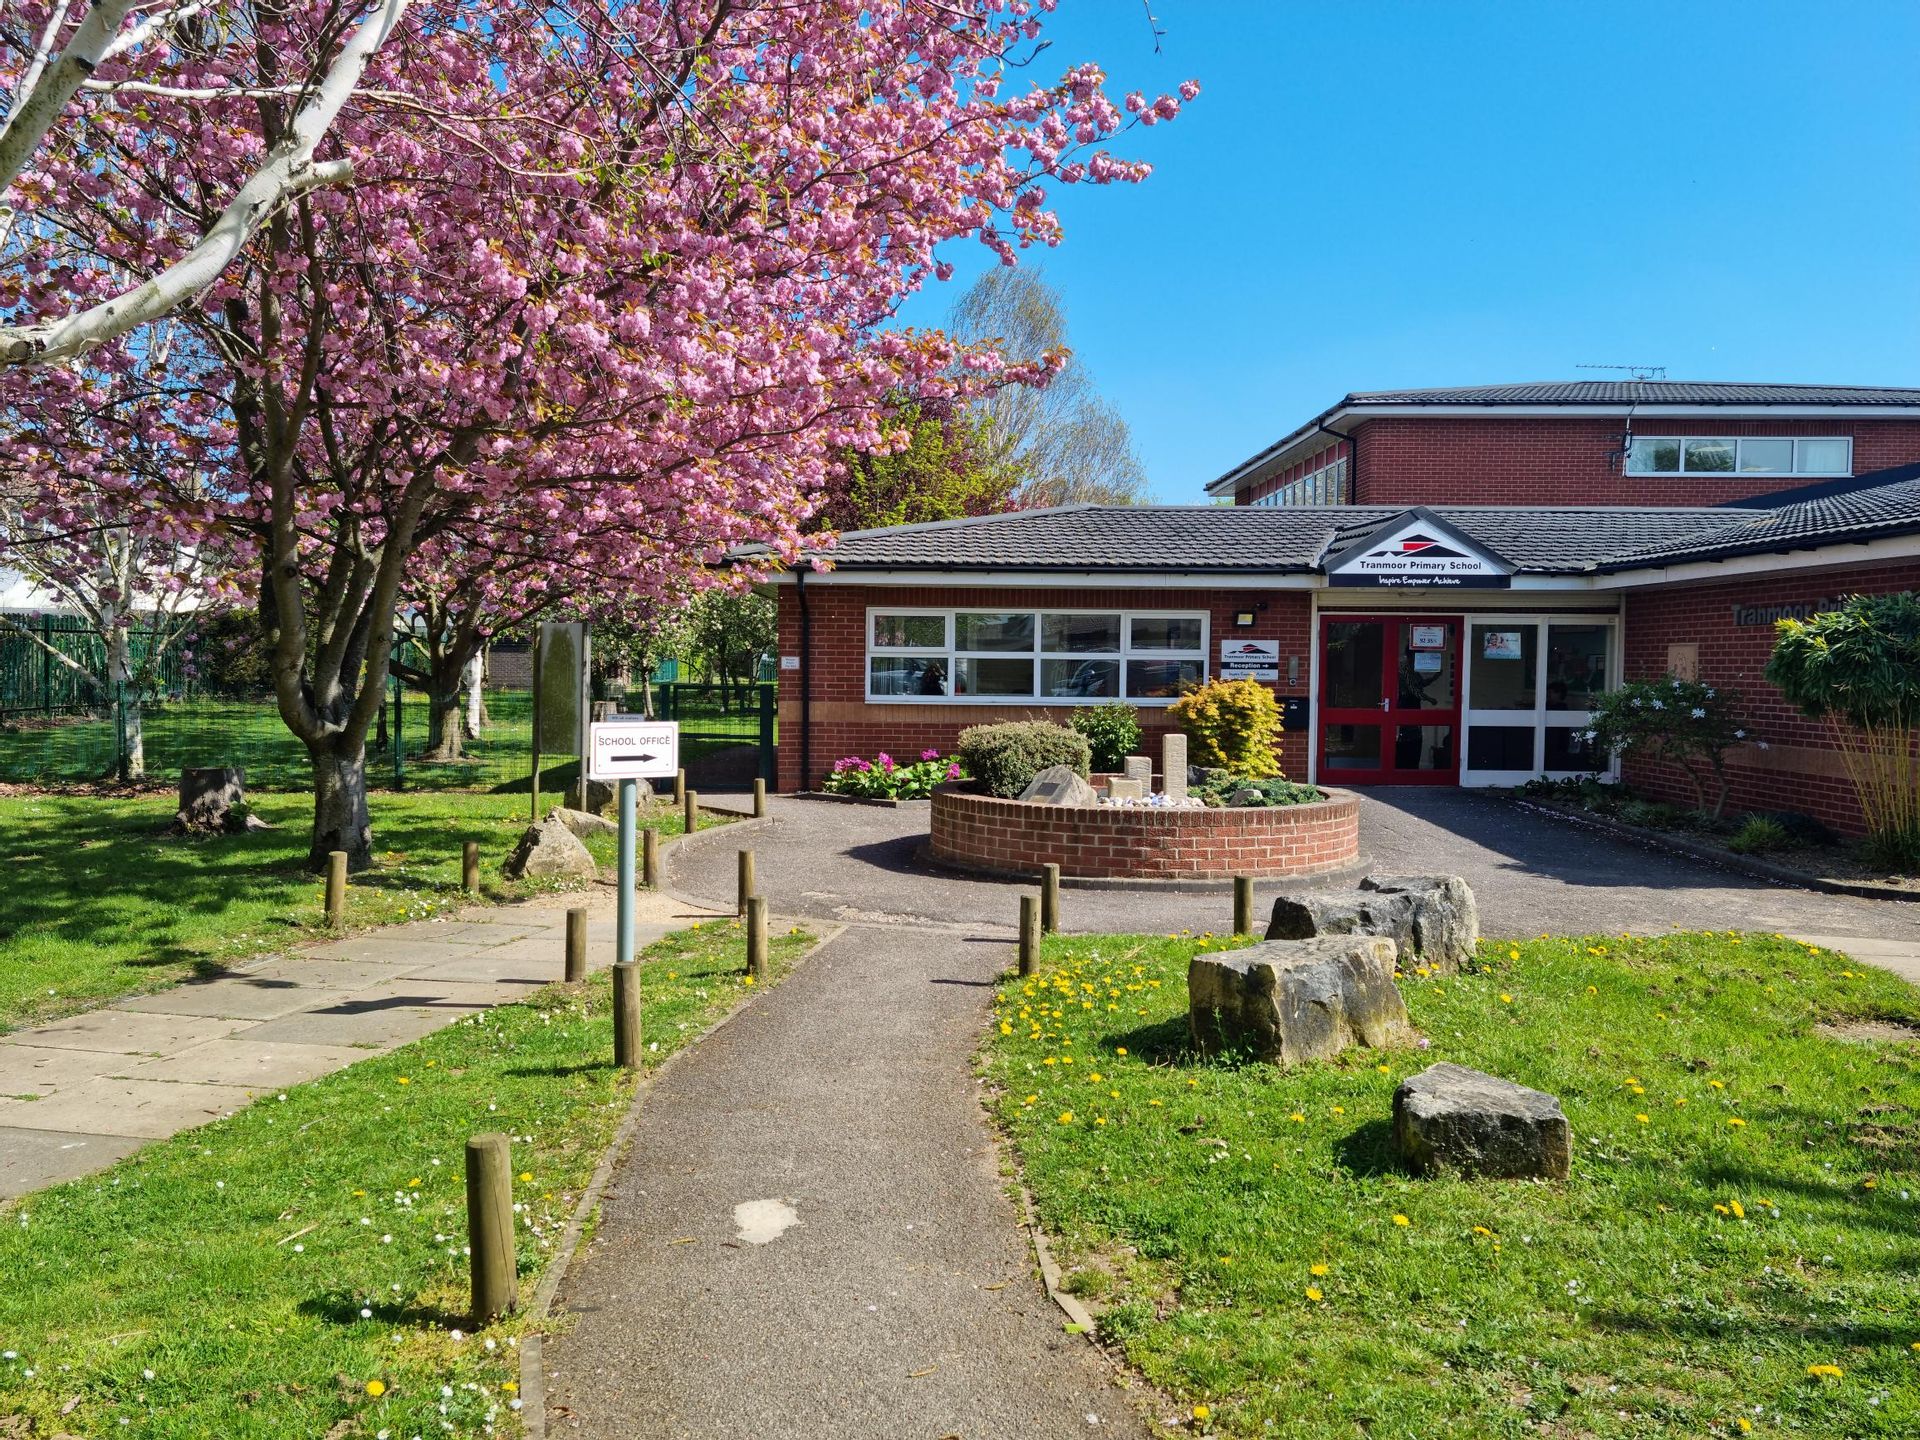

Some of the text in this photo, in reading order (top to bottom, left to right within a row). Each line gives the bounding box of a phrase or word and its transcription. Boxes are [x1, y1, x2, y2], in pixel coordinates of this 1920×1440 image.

[1360, 561, 1481, 571] Tranmoor Primary School
[599, 736, 671, 746] SCHOOL OFFICE
